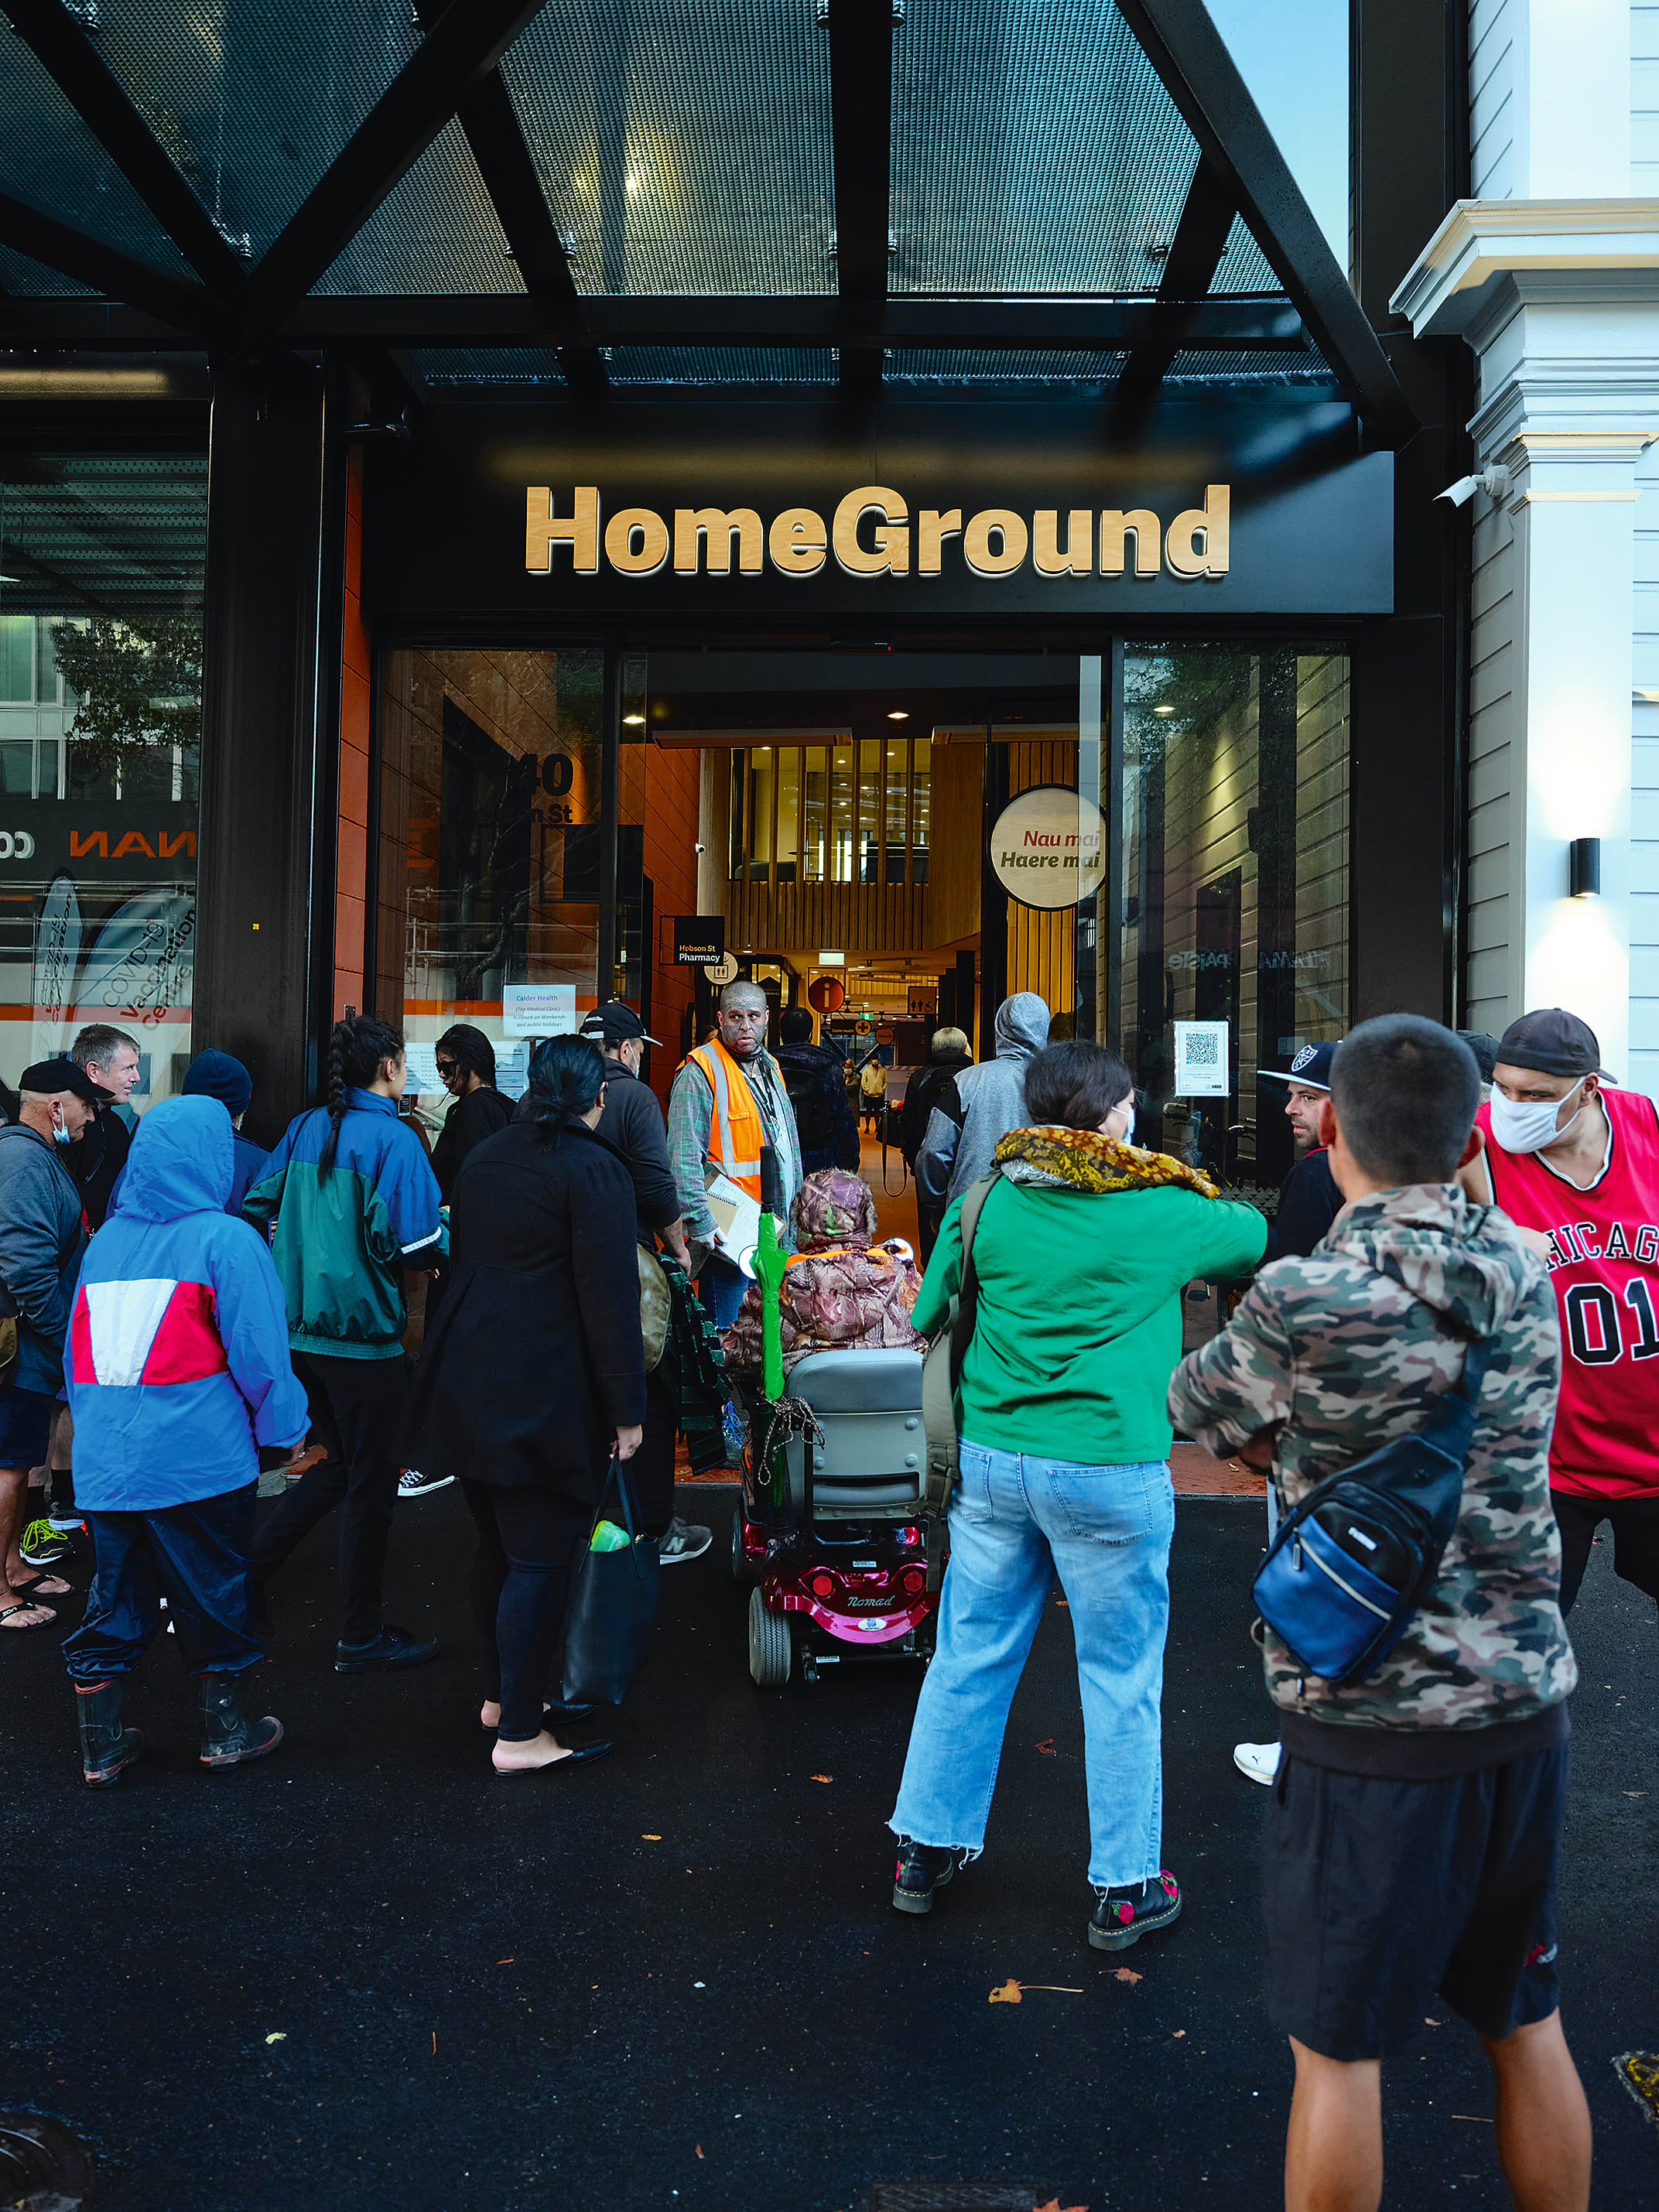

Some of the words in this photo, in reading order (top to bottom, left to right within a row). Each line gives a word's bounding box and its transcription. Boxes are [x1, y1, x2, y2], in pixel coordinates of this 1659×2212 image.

[526, 484, 1232, 577] HomeGround
[548, 803, 573, 823] St
[1023, 830, 1062, 847] Nau
[1064, 830, 1100, 847] mai
[1001, 852, 1059, 868] Haere
[1062, 850, 1101, 868] mai
[103, 922, 164, 1007] COVID-19
[120, 909, 197, 1017] Vaccination
[679, 953, 720, 963] Pharmacy
[1544, 1222, 1659, 1273] HICAG
[1564, 1277, 1659, 1366] 01
[847, 1595, 895, 1607] Nomad
